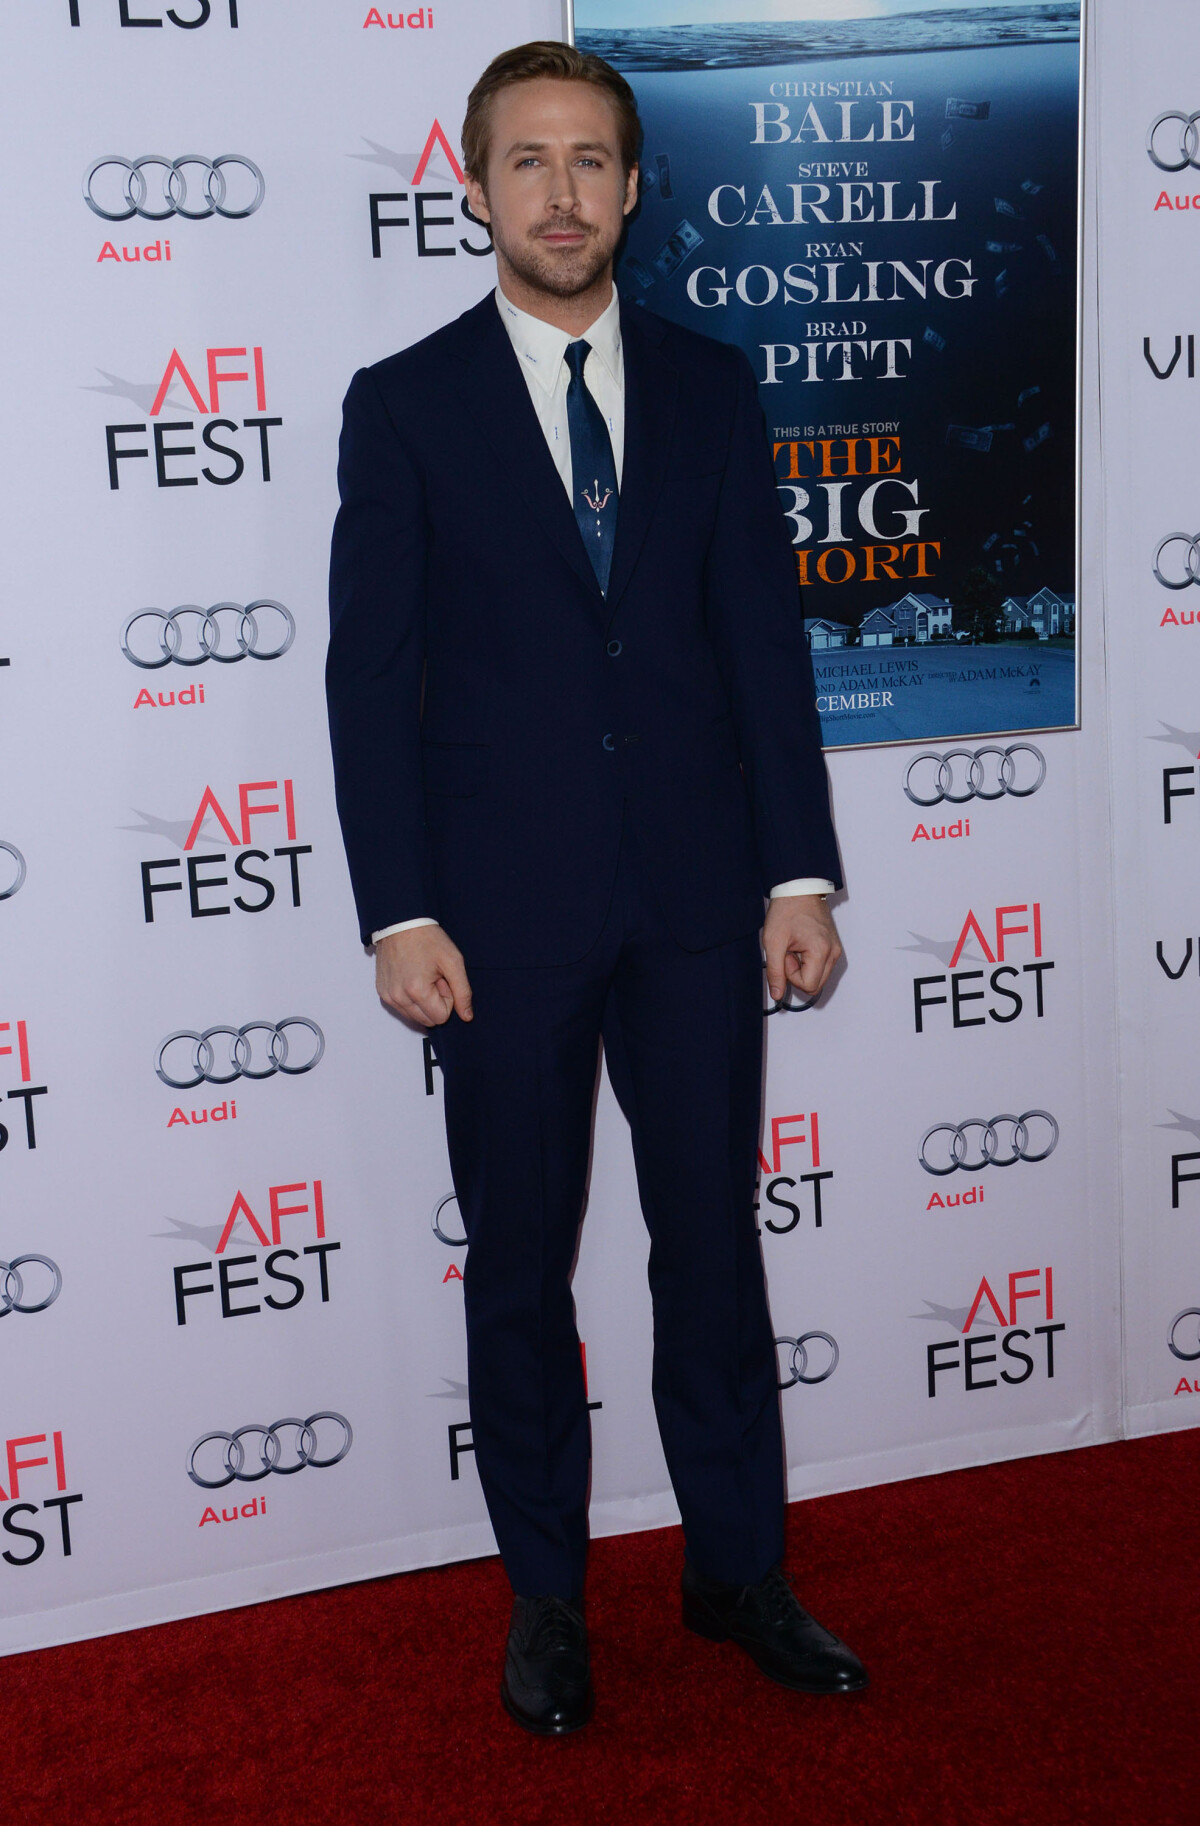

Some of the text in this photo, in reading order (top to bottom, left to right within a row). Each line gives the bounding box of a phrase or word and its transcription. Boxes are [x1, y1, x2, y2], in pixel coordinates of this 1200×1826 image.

[363, 8, 433, 29] Audi
[769, 81, 894, 97] CHRISTIAN
[748, 100, 914, 144] BALE
[799, 162, 868, 178] STEVE
[708, 181, 956, 226] CARELL
[97, 240, 172, 263] Audi
[805, 242, 863, 258] RYAN
[687, 258, 978, 308] GOSLING
[806, 321, 867, 337] BRAD
[759, 339, 911, 384] PITT
[149, 347, 267, 416] AFI
[773, 422, 900, 438] THIS IS A TRUE STORY
[105, 417, 283, 490] FEST
[773, 436, 901, 479] THE
[1160, 608, 1200, 627] Au
[815, 661, 919, 679] MICHAEL LEWIS
[839, 678, 878, 691] ADAM
[882, 674, 926, 688] McKAY
[959, 664, 1042, 681] ADAM McKAY
[134, 684, 205, 709] Audi
[184, 779, 297, 850] AFI
[912, 819, 971, 842] Audi
[141, 845, 312, 923] FEST
[949, 903, 1042, 968] AFI
[914, 962, 1055, 1032] FEST
[167, 1100, 237, 1128] Audi
[926, 1185, 985, 1210] Audi
[215, 1180, 326, 1254] AFI
[173, 1242, 341, 1326] FEST
[962, 1267, 1053, 1333] AFI
[927, 1323, 1066, 1398] FEST
[199, 1496, 267, 1527] Audi
